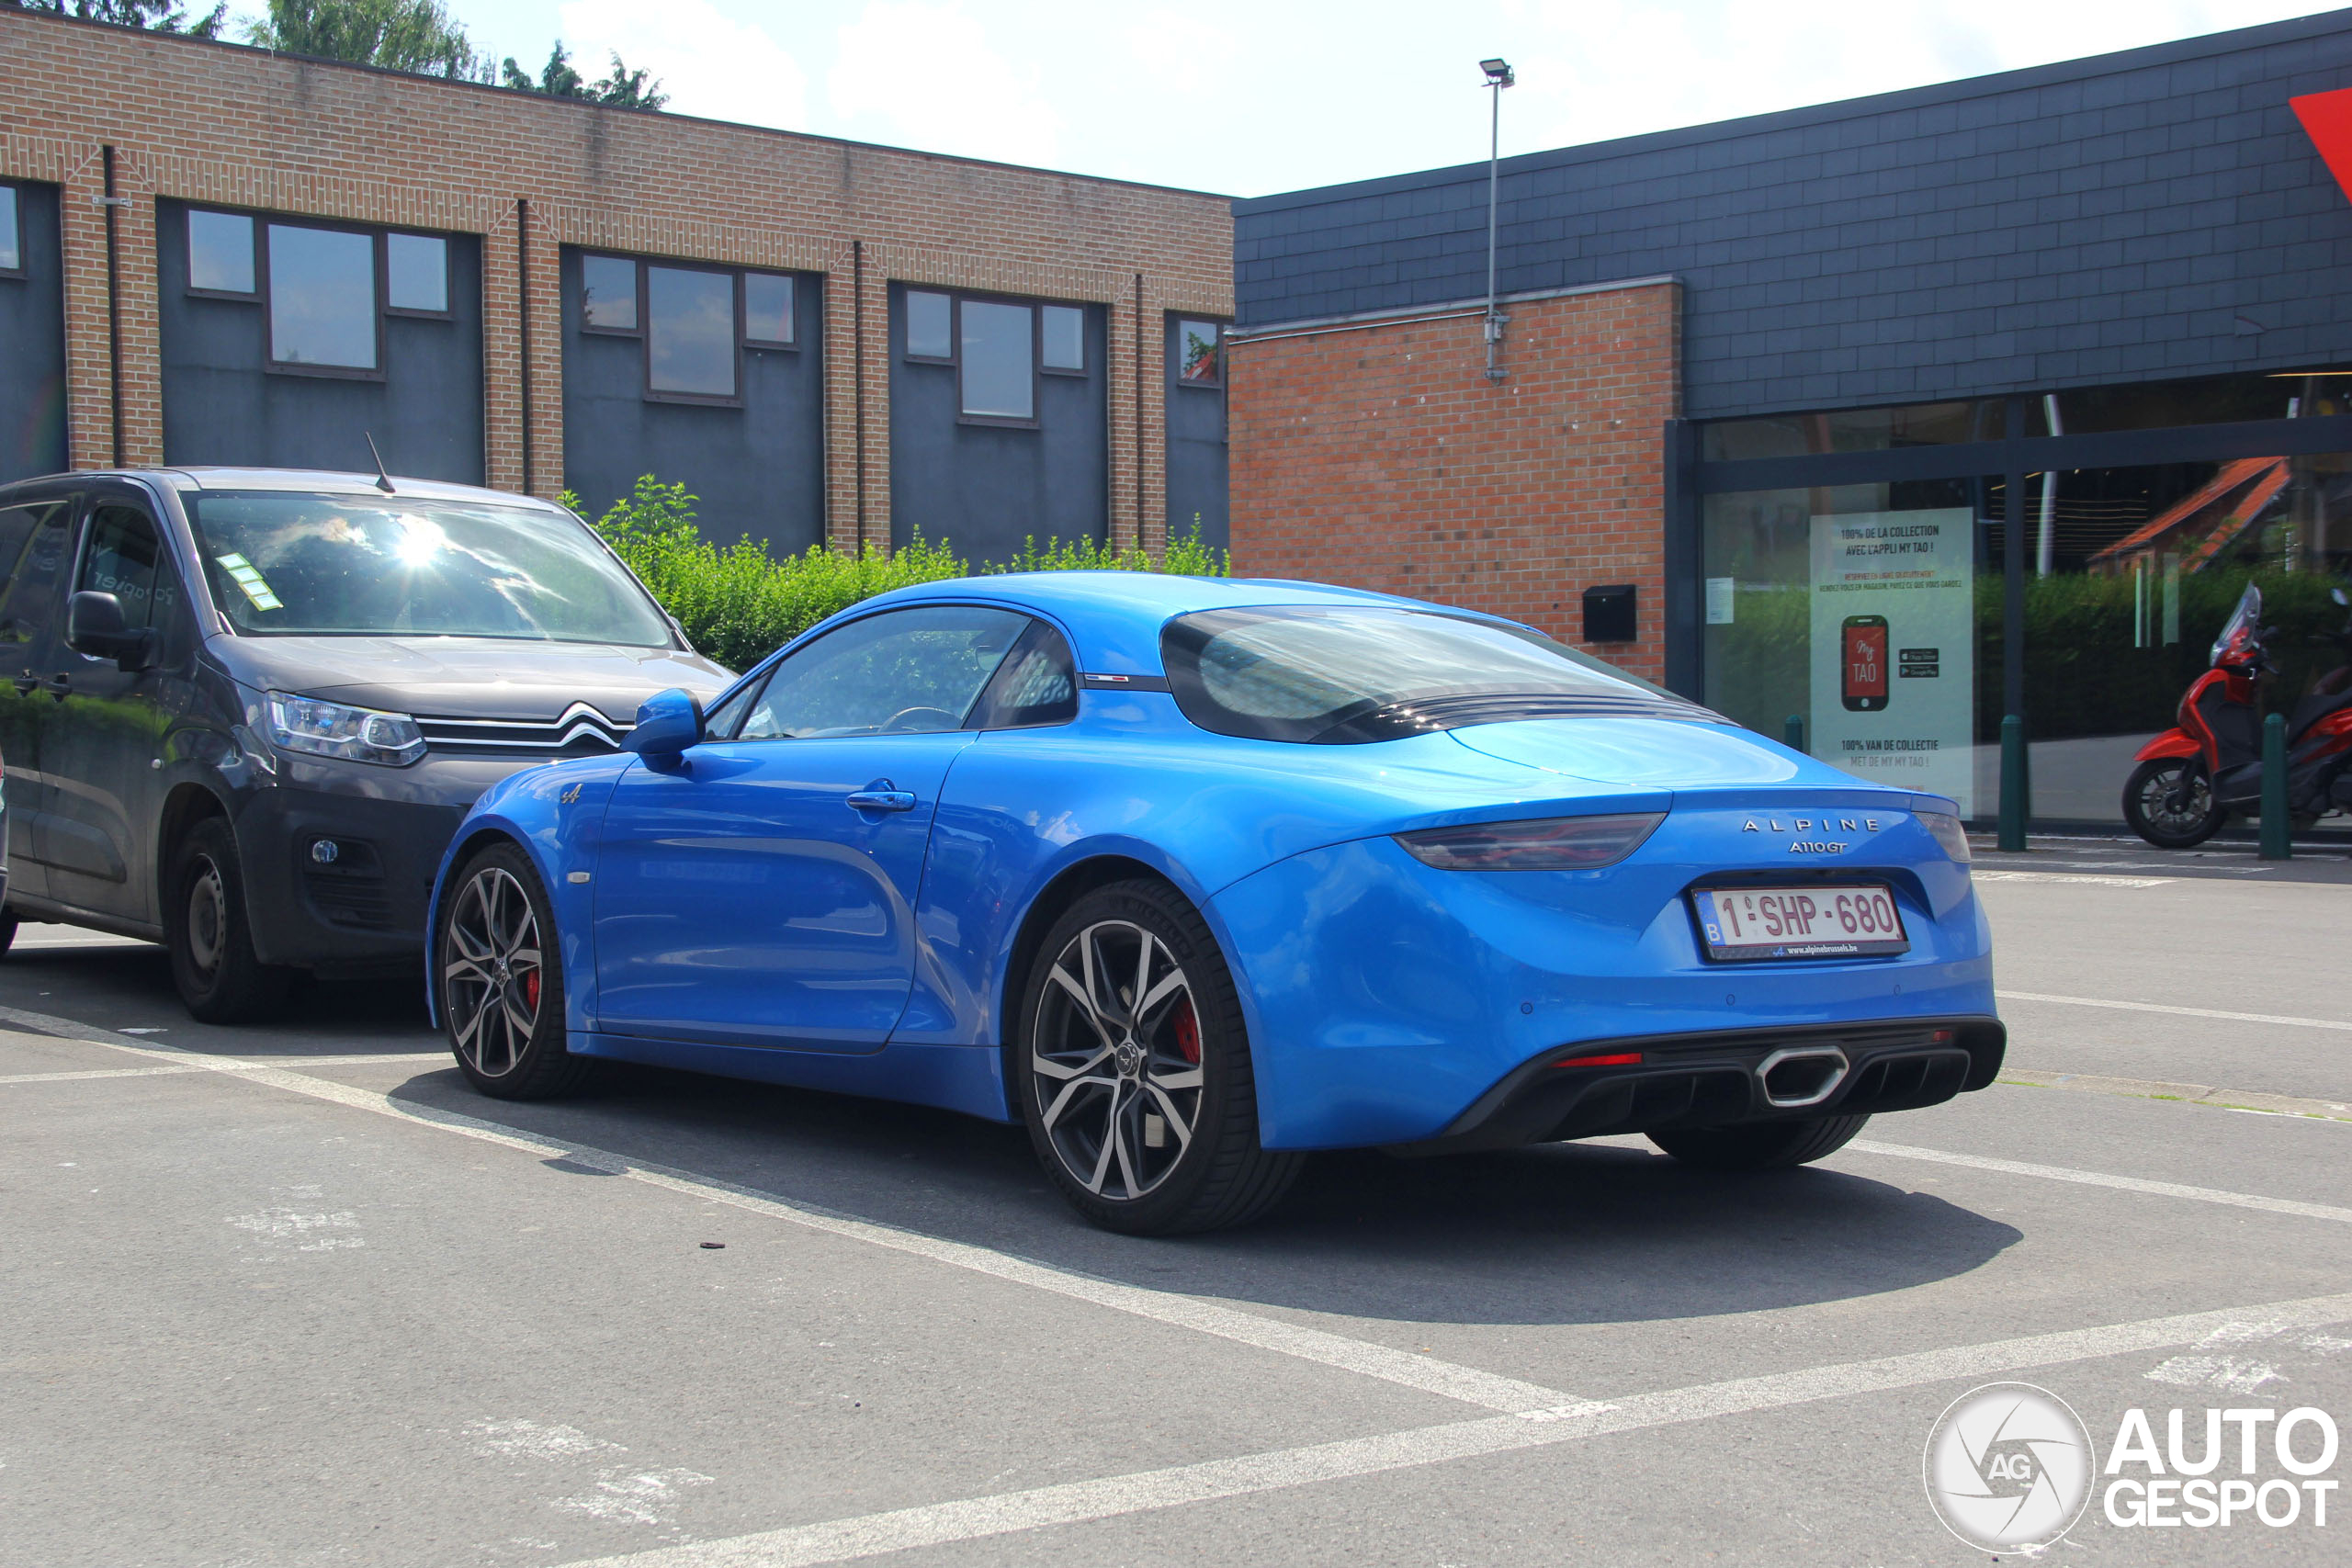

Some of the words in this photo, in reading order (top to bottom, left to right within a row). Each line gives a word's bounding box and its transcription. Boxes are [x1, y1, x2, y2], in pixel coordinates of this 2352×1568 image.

[1841, 529, 1863, 540] 100%
[1866, 528, 1876, 539] DE
[1878, 527, 1887, 538] LA
[1890, 525, 1939, 537] COLLECTION
[1846, 545, 1866, 557] AVEC
[1868, 543, 1897, 556] L'APPLI
[1899, 543, 1910, 554] MY
[1913, 542, 1928, 553] TAO
[1856, 639, 1875, 662] My
[1852, 663, 1876, 682] TAO
[1841, 740, 1863, 750] 100%
[1866, 740, 1882, 750] VAN
[1883, 740, 1894, 750] DE
[1895, 739, 1939, 750] COLLECTIE
[1850, 756, 1868, 767] MET
[1869, 756, 1879, 767] DE
[1881, 756, 1893, 767] MY
[1894, 756, 1906, 767] MY
[1908, 756, 1924, 767] TAO
[1743, 818, 1882, 832] ALPINE
[1706, 923, 1721, 942] B
[1787, 944, 1858, 955] www.alpinebrussels.be
